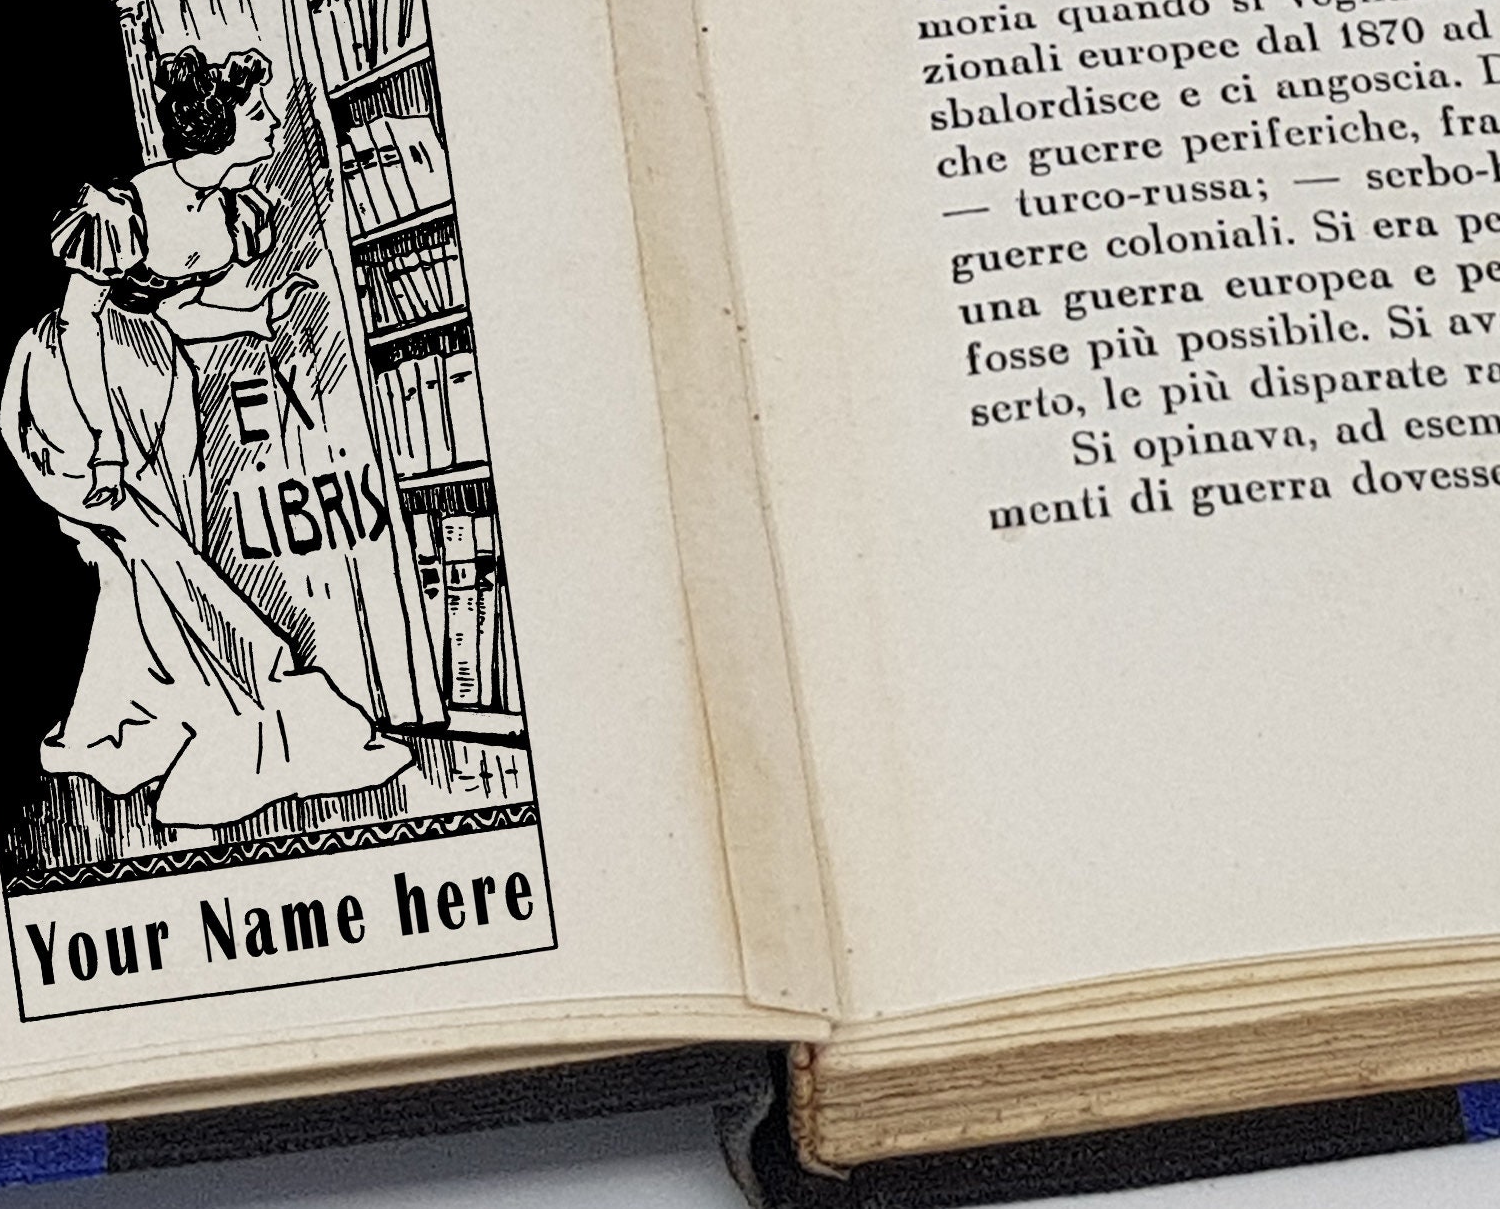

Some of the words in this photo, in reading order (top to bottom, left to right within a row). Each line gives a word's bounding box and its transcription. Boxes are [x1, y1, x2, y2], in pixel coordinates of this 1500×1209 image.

[917, 3, 1038, 40] moria
[922, 42, 1064, 85] zionali
[1078, 38, 1240, 70] europee
[1256, 21, 1321, 56] dal
[1340, 16, 1425, 50] 1870
[1443, 8, 1493, 42] ad
[930, 84, 1161, 132] sbalordisce
[1179, 86, 1202, 109] e
[1220, 73, 1258, 105] ci
[1276, 60, 1463, 105] angoscia.
[936, 143, 1008, 179] che
[1028, 138, 1163, 177] guerre
[1180, 109, 1420, 165] periferiche,
[1439, 104, 1500, 138] fra
[1015, 177, 1269, 218] turco-russa;
[951, 240, 1089, 285] guerre
[1106, 214, 1296, 259] coloniali.
[1312, 209, 1356, 244] Si
[1372, 215, 1440, 240] era
[1455, 211, 1500, 244] pe
[957, 296, 1042, 326] una
[1064, 281, 1205, 322] guerra
[1225, 267, 1395, 302] europea
[1413, 264, 1437, 287] e
[966, 340, 1070, 377] fosse
[1086, 325, 1160, 371] più
[1176, 309, 1370, 363] possibile.
[1387, 304, 1433, 340] Si
[1448, 311, 1497, 337] av
[970, 386, 1087, 428] serto,
[1102, 375, 1142, 411] le
[1158, 369, 1232, 416] più
[1249, 356, 1449, 405] disparate
[1071, 430, 1117, 467] Si
[1133, 422, 1318, 468] opinava,
[1336, 406, 1387, 446] ad
[1404, 413, 1500, 441] esem
[988, 484, 1112, 531] menti
[1130, 476, 1174, 515] di
[1191, 476, 1333, 518] guerra
